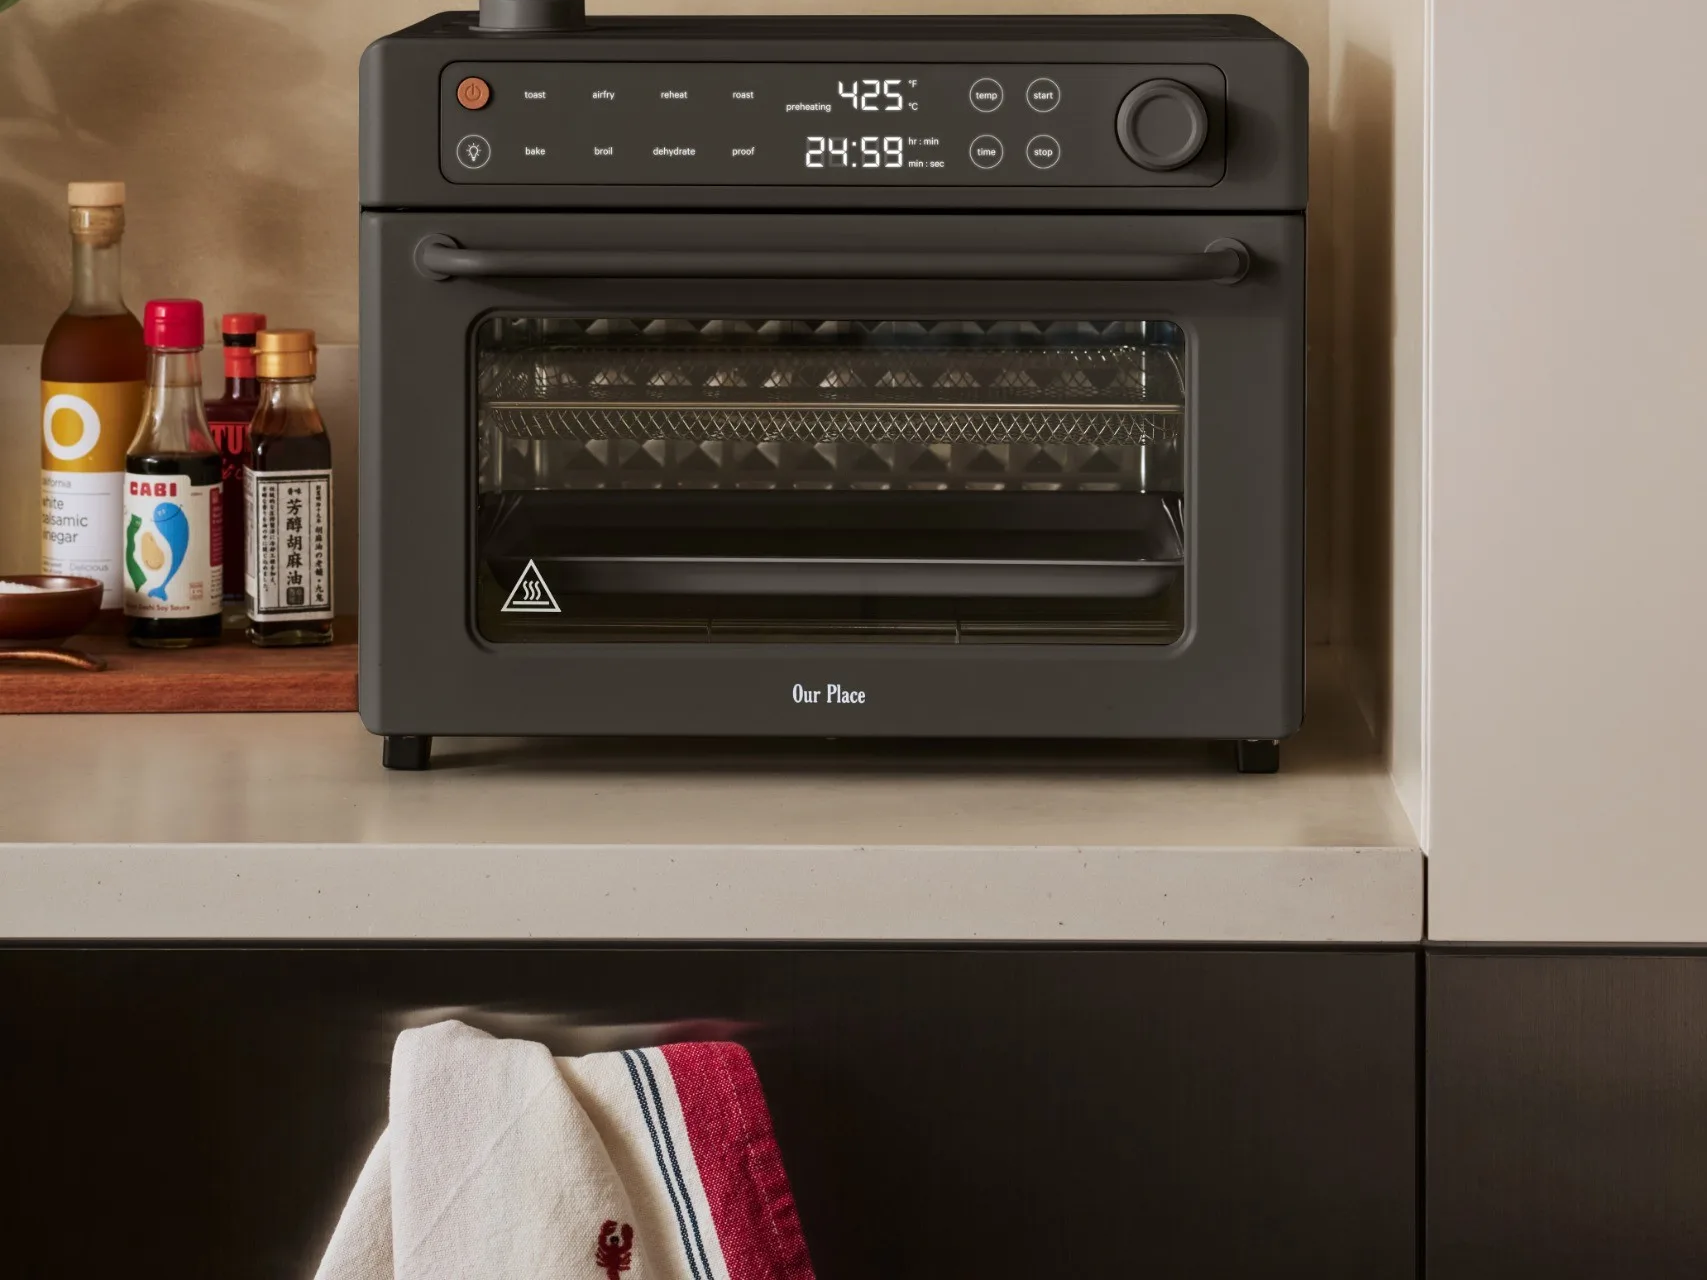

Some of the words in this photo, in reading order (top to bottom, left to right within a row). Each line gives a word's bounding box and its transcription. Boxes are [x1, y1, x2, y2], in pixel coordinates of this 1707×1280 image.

[524, 90, 546, 100] toast
[592, 89, 615, 101] airfry
[660, 90, 688, 100] reheat
[732, 90, 754, 100] roast
[837, 79, 903, 111] 425
[975, 91, 998, 102] temp
[1033, 91, 1054, 100] start
[786, 102, 832, 113] preheating
[908, 137, 918, 146] hr
[923, 137, 939, 146] min
[525, 146, 546, 156] bake
[594, 146, 613, 156] broil
[652, 146, 696, 158] dehydrate
[732, 146, 755, 158] proof
[805, 136, 903, 168] 24:59
[977, 148, 996, 157] time
[1034, 148, 1053, 158] stop
[908, 160, 924, 168] min
[130, 481, 177, 497] CABI
[792, 683, 821, 704] Our
[826, 683, 866, 704] Place
